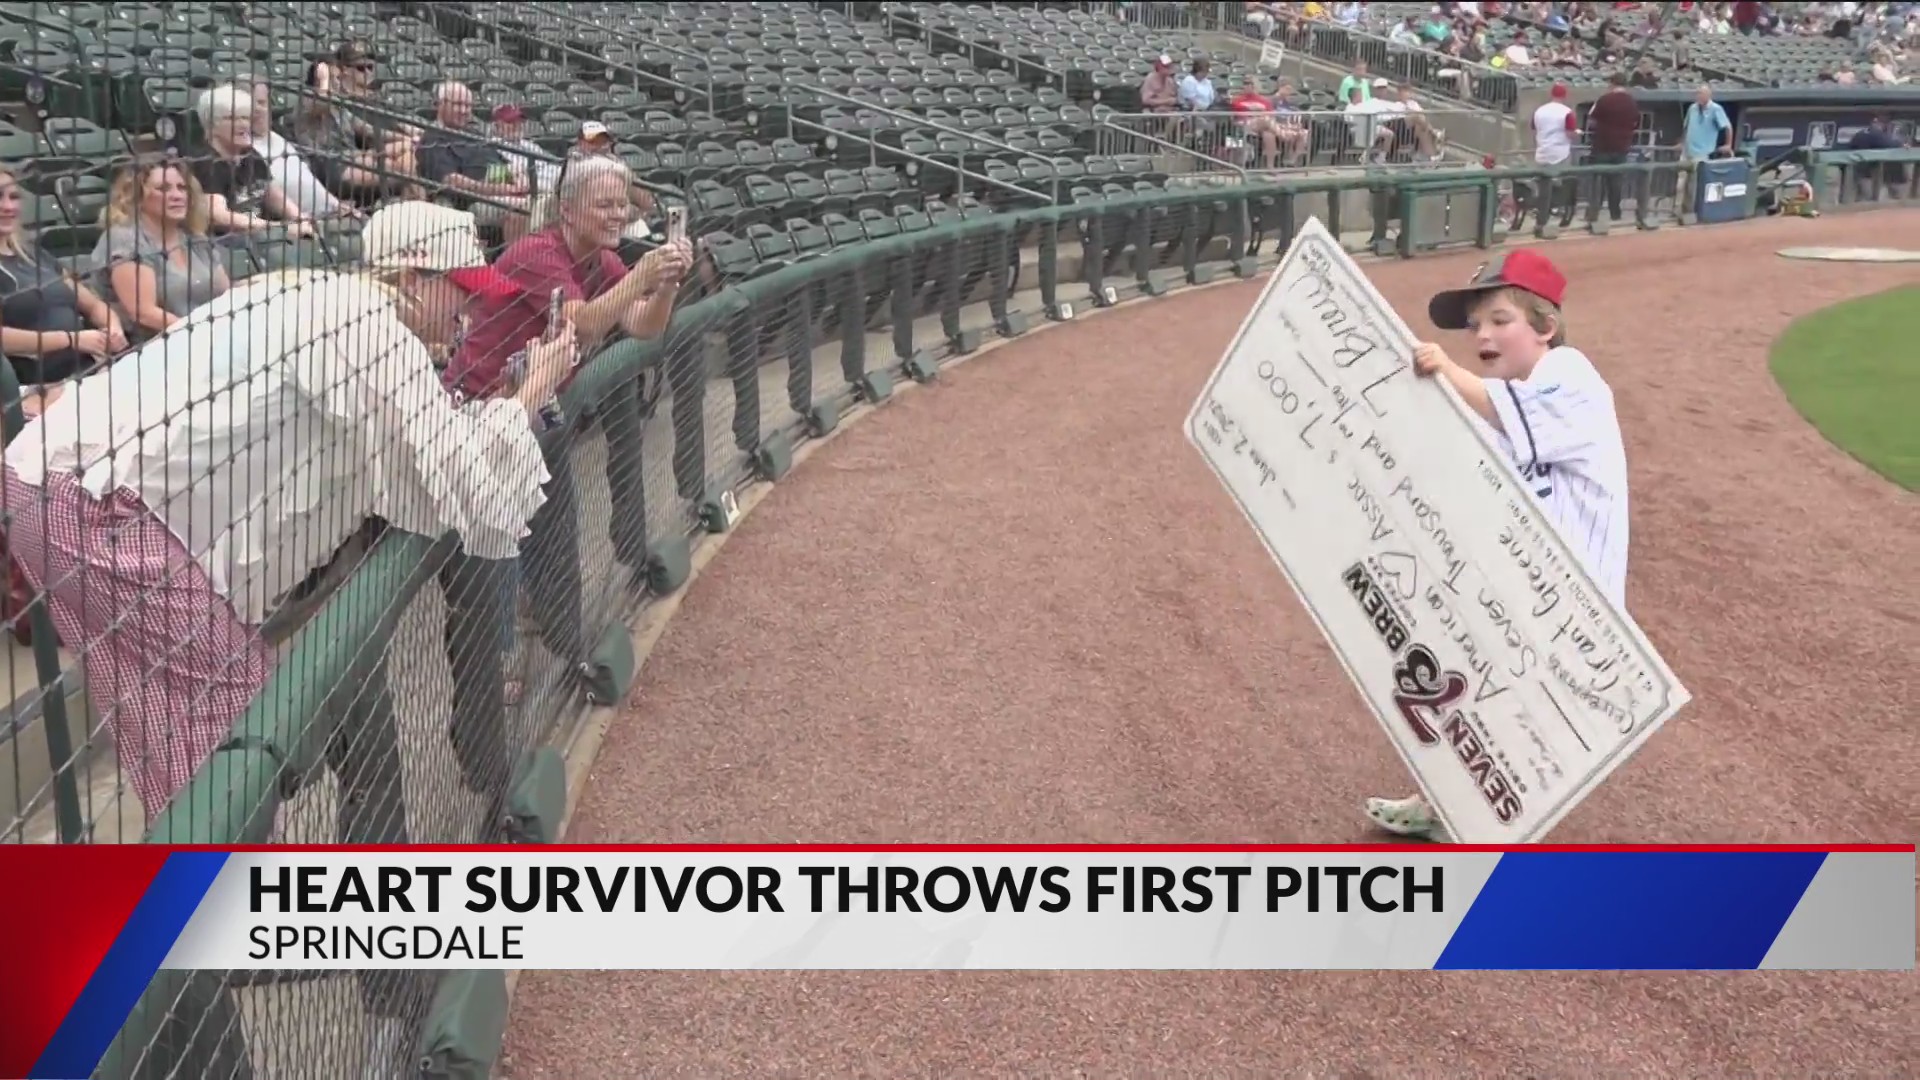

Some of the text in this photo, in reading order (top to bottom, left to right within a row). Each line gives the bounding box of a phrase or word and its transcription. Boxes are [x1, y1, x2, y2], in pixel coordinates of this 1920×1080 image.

[1288, 270, 1377, 367] Brew
[1258, 361, 1331, 449] 7,000
[1360, 430, 1395, 469] and
[1390, 476, 1465, 594] Thousand
[1499, 526, 1559, 617] Greene
[1343, 562, 1409, 652] BREW
[1425, 586, 1508, 702] American
[1477, 588, 1536, 677] Seven
[1551, 615, 1618, 691] Grant
[1443, 710, 1521, 821] SEVEN
